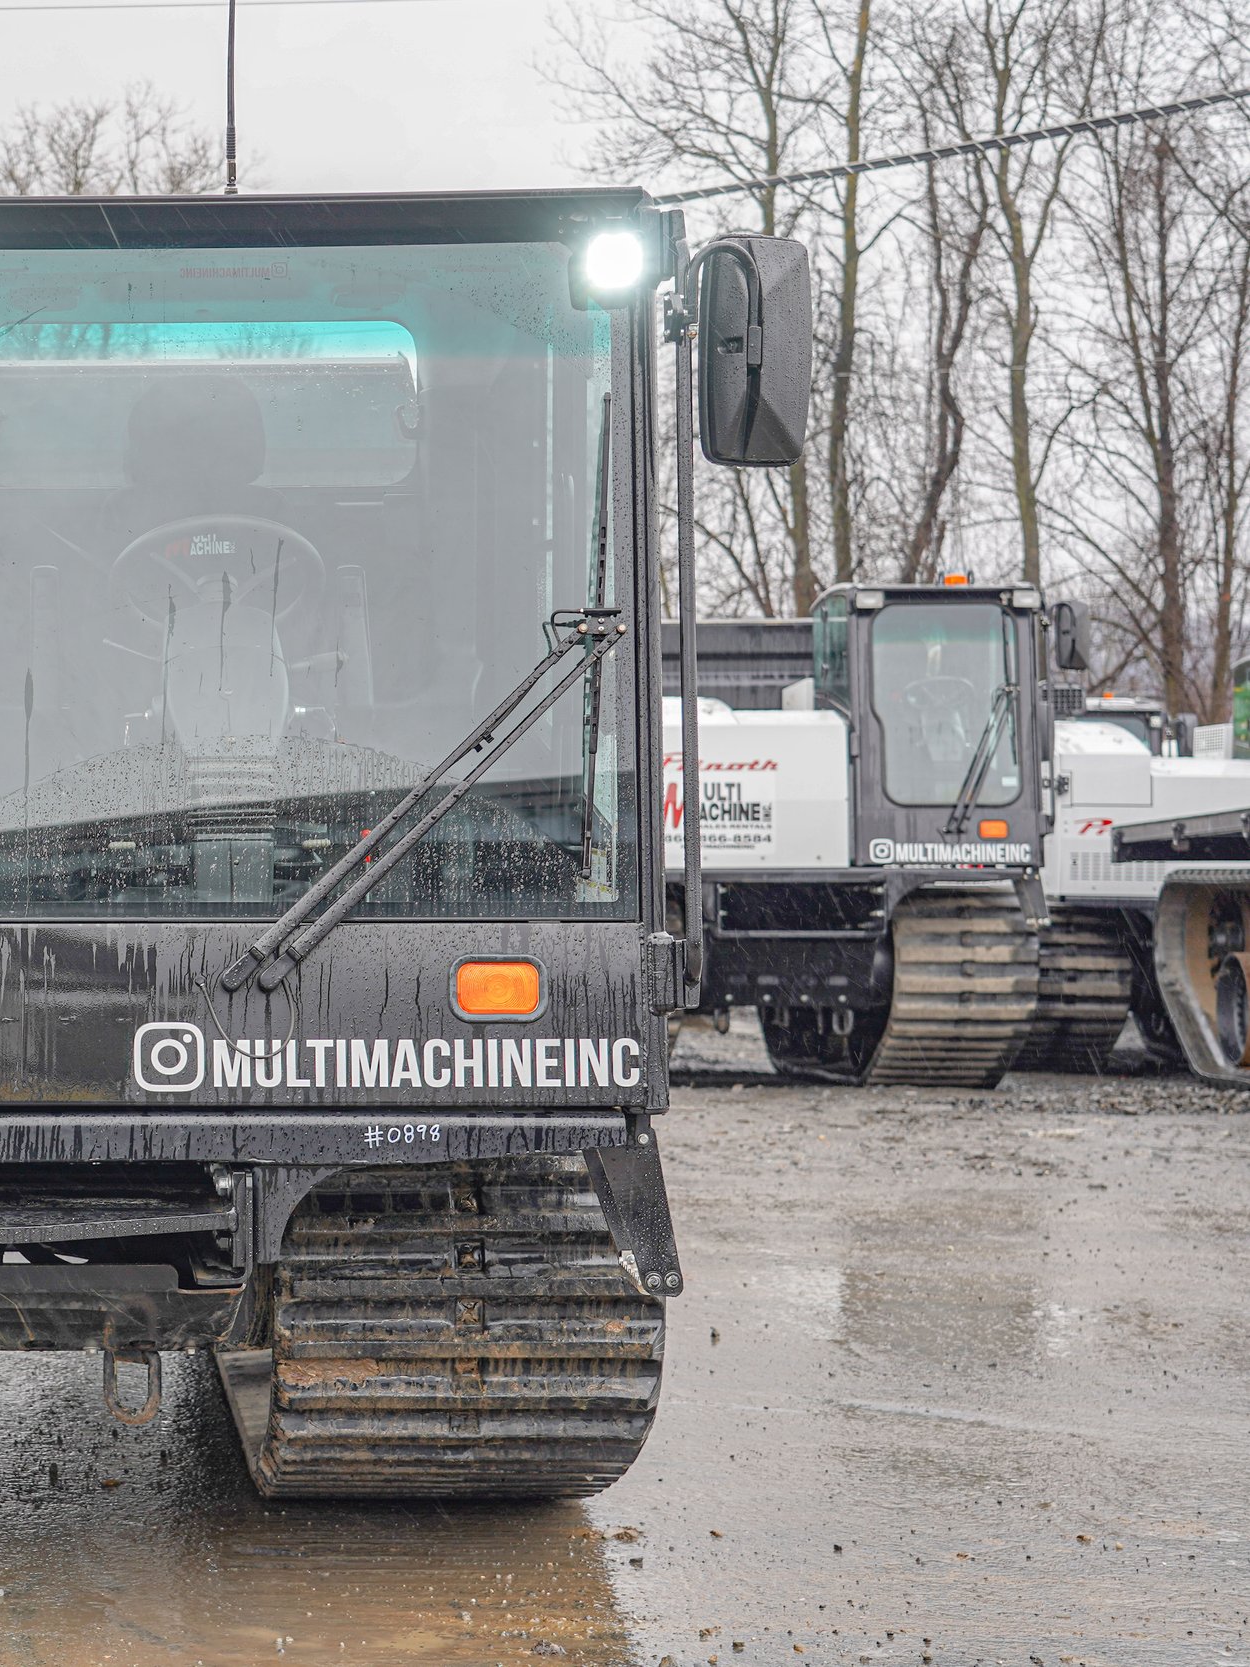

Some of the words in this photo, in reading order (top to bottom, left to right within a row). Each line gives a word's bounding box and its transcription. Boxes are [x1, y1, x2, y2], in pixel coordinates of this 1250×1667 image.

[895, 842, 1031, 863] MULTIMACHINEINC
[213, 1038, 640, 1089] MULTIMACHINEINC
[364, 1124, 440, 1149] #0898
